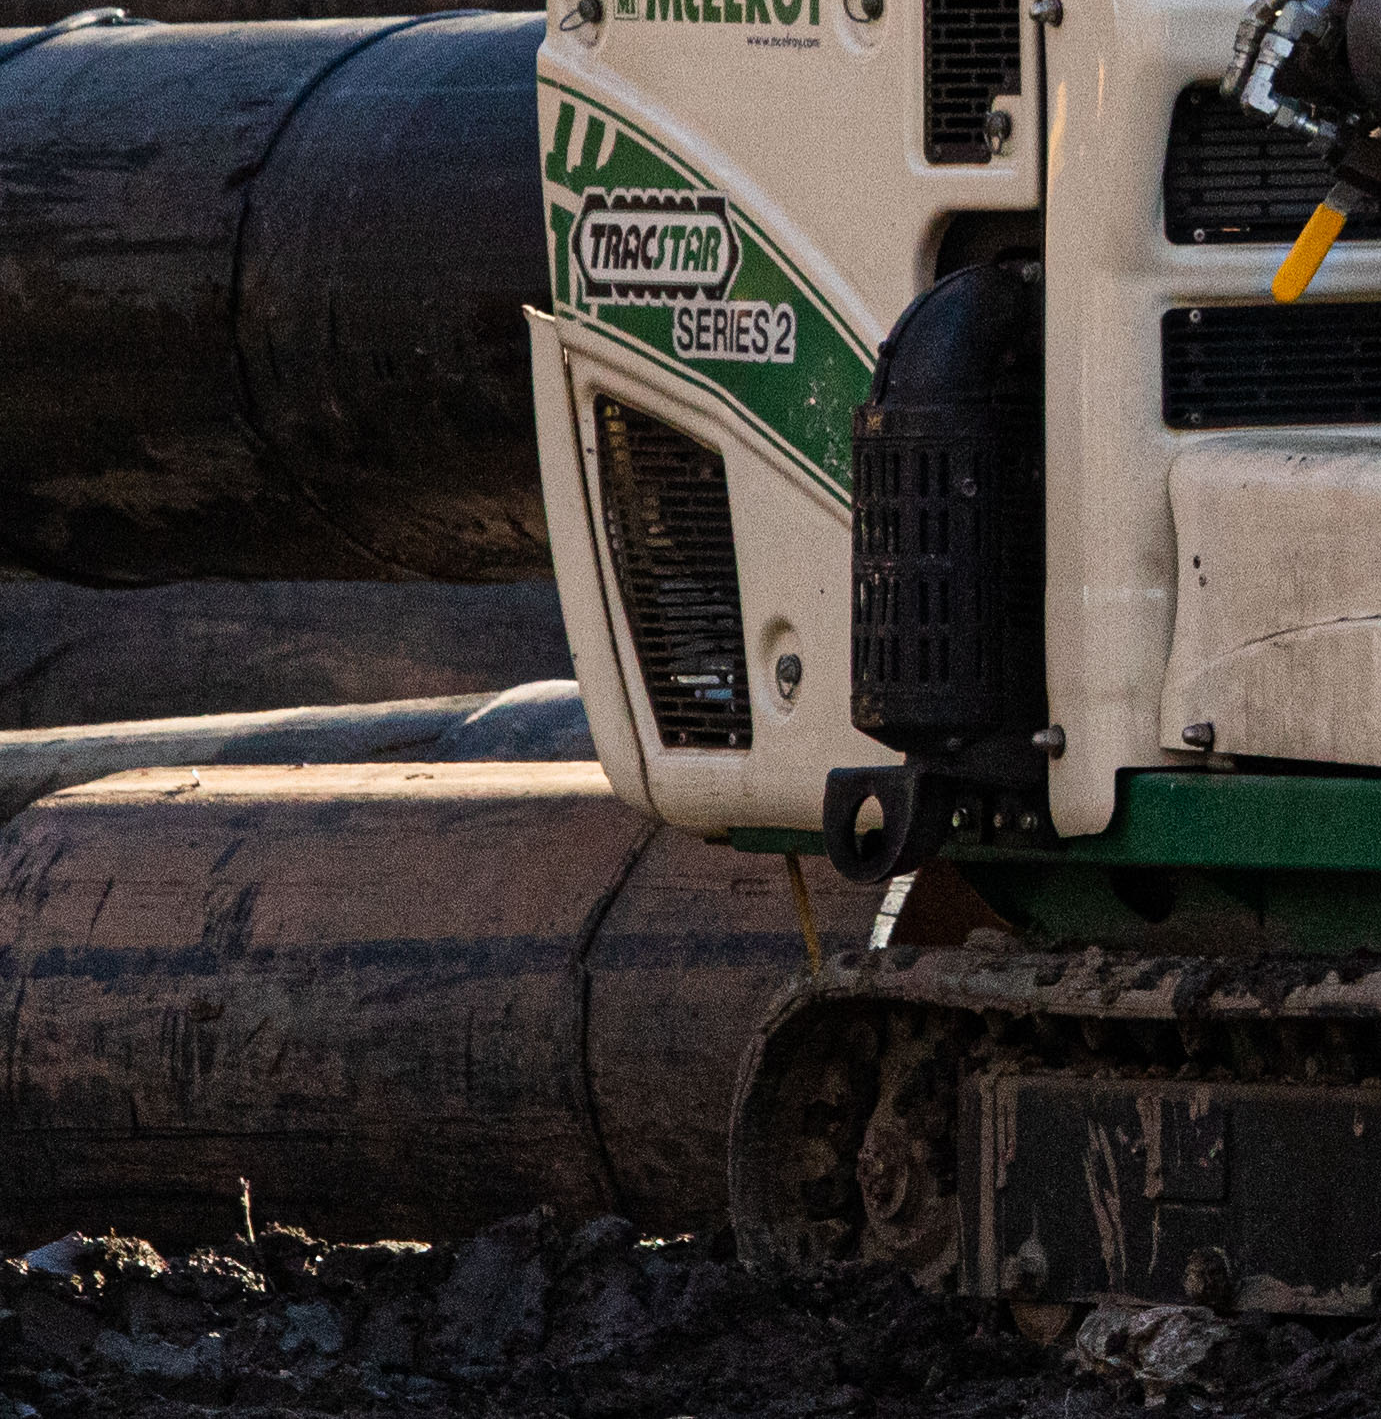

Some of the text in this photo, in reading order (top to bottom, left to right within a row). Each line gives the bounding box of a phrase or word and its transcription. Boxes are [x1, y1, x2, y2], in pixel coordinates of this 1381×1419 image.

[746, 33, 821, 50] www.mcelroy.com
[590, 223, 723, 272] TRACSTAR
[677, 307, 791, 355] SERIES 2
